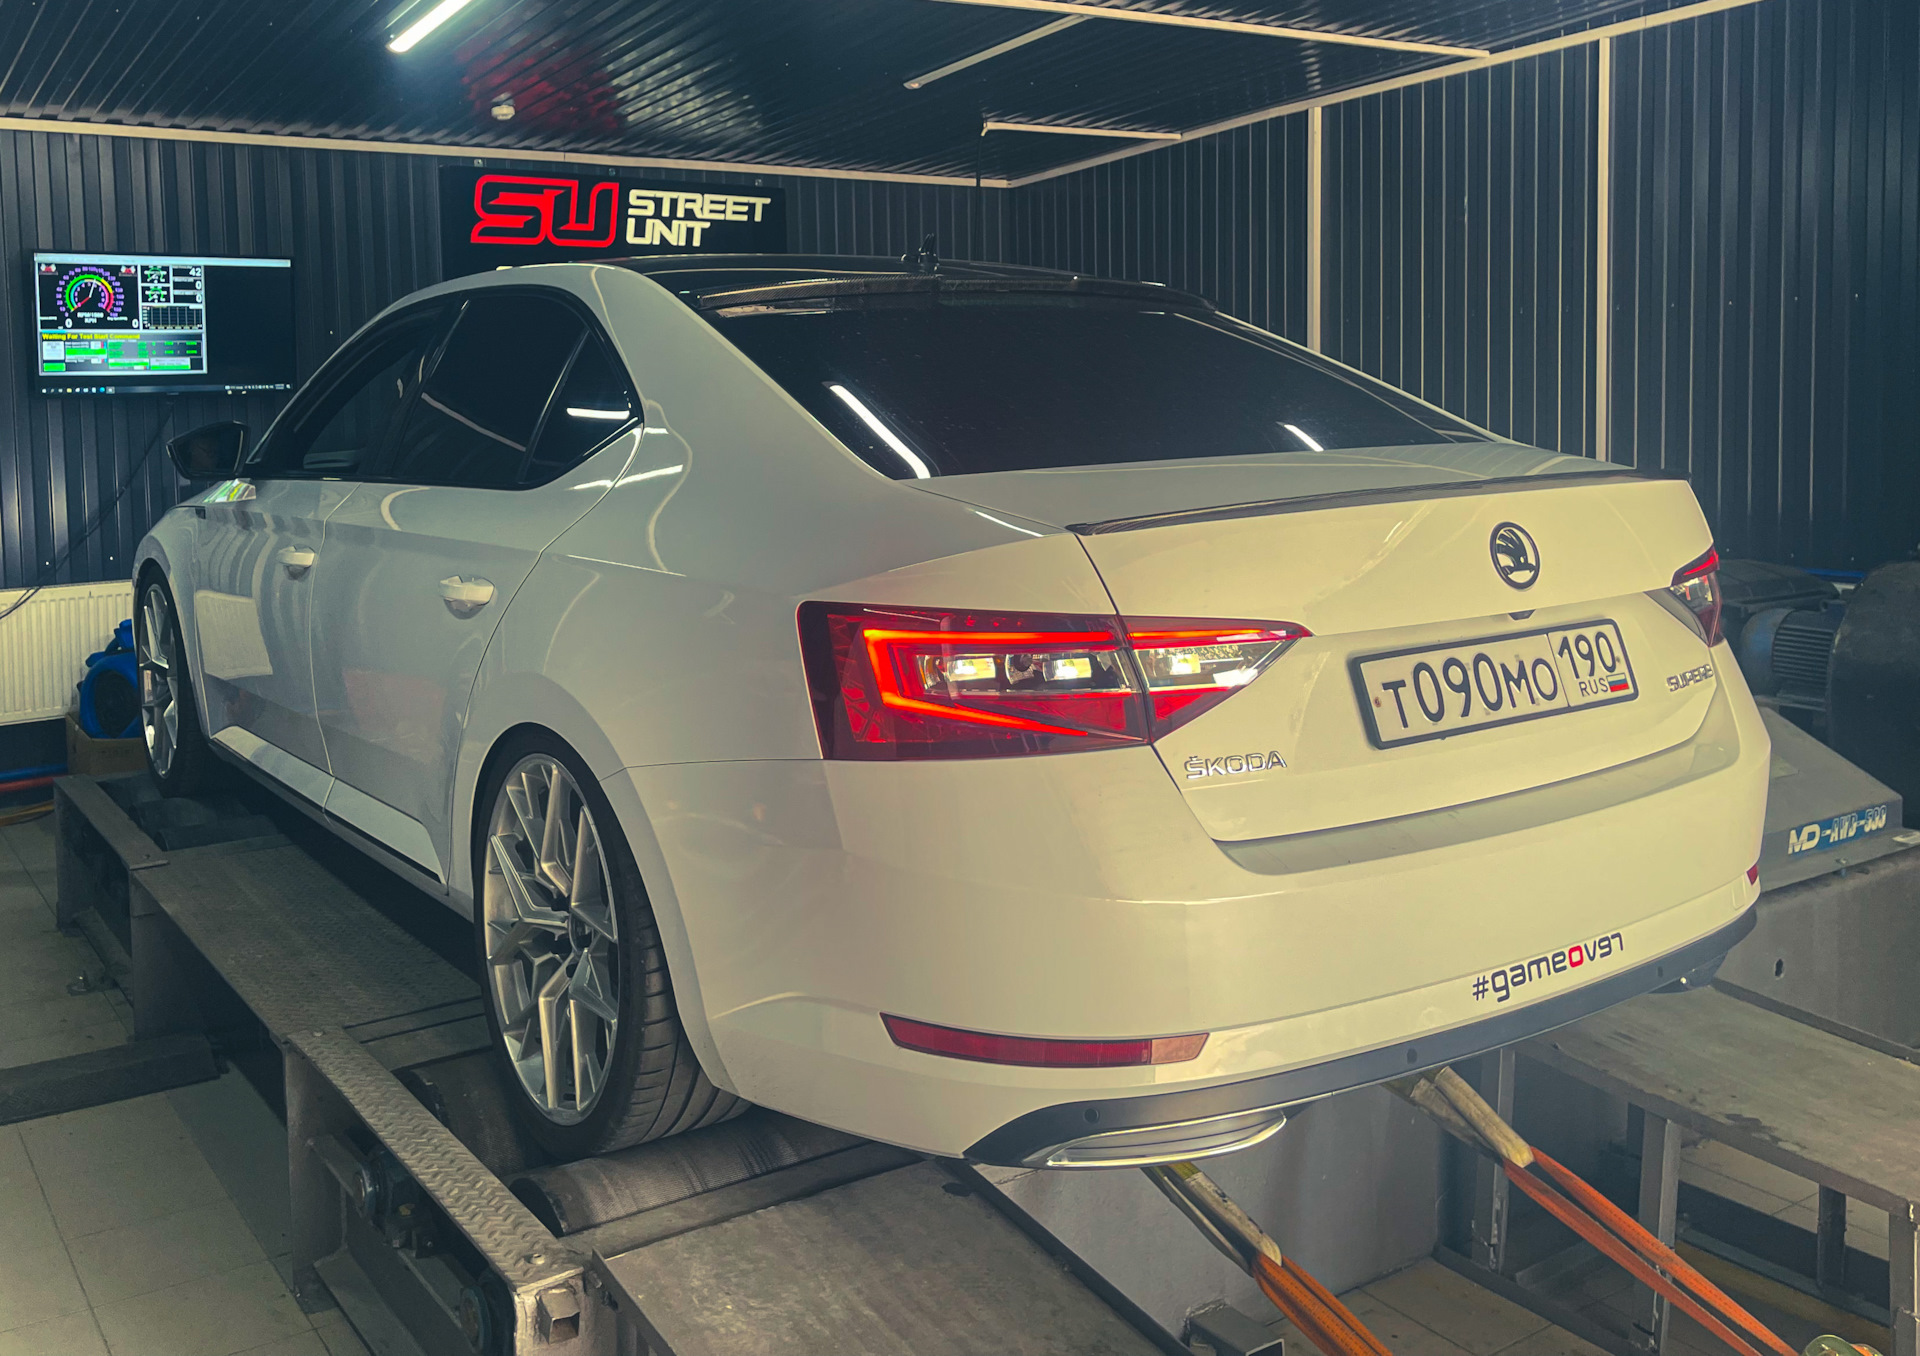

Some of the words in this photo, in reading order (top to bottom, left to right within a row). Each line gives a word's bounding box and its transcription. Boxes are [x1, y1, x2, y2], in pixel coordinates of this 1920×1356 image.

[470, 174, 619, 248] SU
[628, 188, 772, 222] STREET
[626, 217, 711, 247] UNIT
[189, 267, 202, 276] 42
[195, 280, 202, 290] 0
[195, 294, 202, 303] 0
[65, 318, 73, 328] 0
[132, 318, 139, 328] 0
[1557, 631, 1617, 679] 190
[1580, 676, 1608, 697] RUS
[1666, 664, 1713, 692] SUPERB
[1184, 751, 1287, 779] ŠKODA
